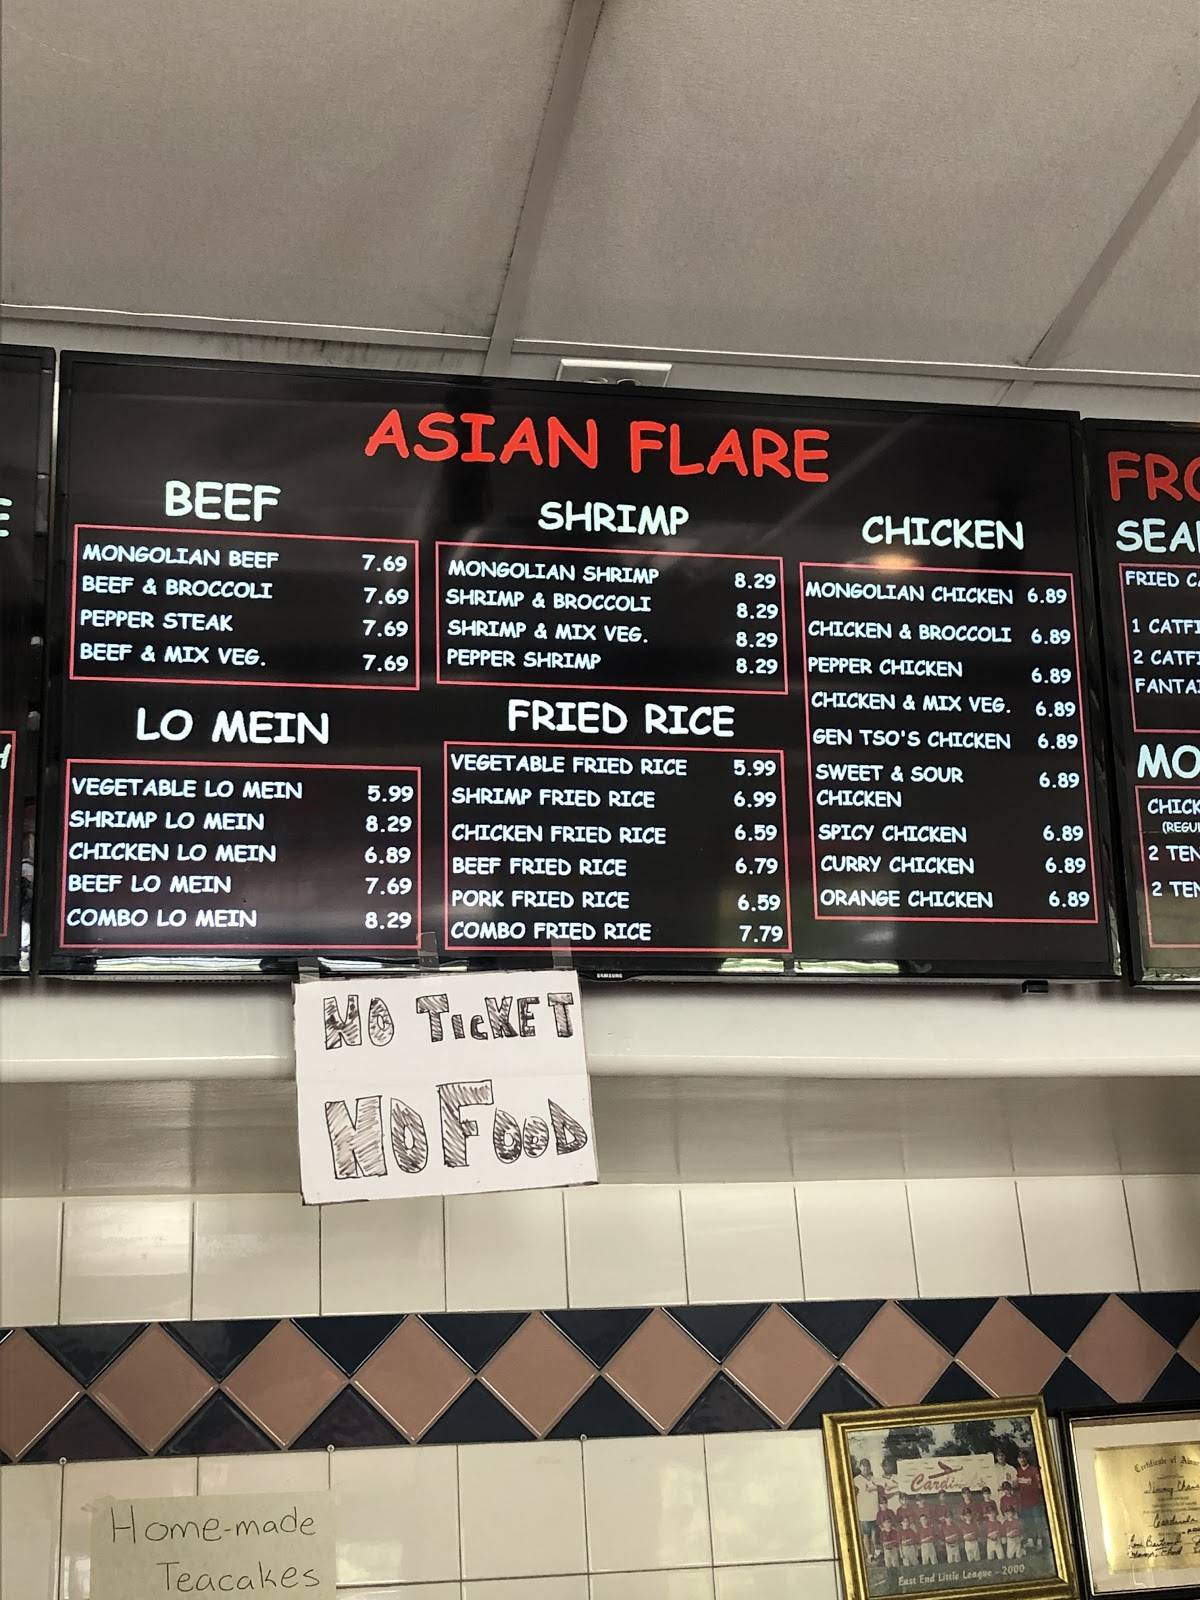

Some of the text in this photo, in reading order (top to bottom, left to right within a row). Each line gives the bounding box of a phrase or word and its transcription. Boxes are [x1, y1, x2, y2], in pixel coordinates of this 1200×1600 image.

[364, 407, 829, 482] ASIAN FLARE
[166, 481, 281, 522] BEEF
[538, 501, 689, 536] SHRIMP
[862, 516, 1023, 550] CHICKEN
[1116, 518, 1200, 553] SEA
[83, 544, 407, 572] MONGOLIAN BEEF 7.69
[449, 560, 776, 589] MONGOLIAN SHRIMP 8.29
[1125, 571, 1200, 588] FRIED C
[83, 575, 409, 604] BEEF & BROCCOLI 7.69
[806, 582, 1067, 604] MONGOLIAN CHICKEN 6.89
[446, 589, 778, 619] SHRIMP & BROCCOLI 8.29
[81, 609, 408, 637] PEPPER STEAK 7.69
[448, 620, 778, 648] SHRIMP & MIX VEG. 8.29
[808, 621, 1070, 644] CHICKEN & BROCCOLI 6.89
[1132, 619, 1140, 632] 1
[80, 643, 408, 671] BEEF & MIX VEG. 7.69
[447, 649, 777, 674] PEPPER SHRIMP 8.29
[1133, 650, 1143, 664] 2
[808, 657, 1071, 683] PEPPER CHICKEN 6.89
[812, 692, 1075, 717] CHICKEN & MIX VEG. 6.89
[137, 708, 328, 744] LO MEIN
[509, 699, 734, 737] FRIED RICE
[813, 729, 1078, 749] GEN TSO'S CHICKEN 6.89
[451, 754, 776, 776] VEGETABLE FRIED RICE 5.99
[816, 764, 1079, 788] SWEET & SOUR 6.89
[71, 775, 413, 802] VEGETABLE LO MEIN 5.99
[452, 787, 776, 808] SHRIMP FRIED RICE 6.99
[817, 790, 901, 807] CHICKEN
[68, 811, 412, 832] SHRIMP LO MEIN 8.29
[818, 824, 1083, 842] SPICY CHICKEN 6.89
[452, 824, 777, 844] CHICKEN FRIED RICE 6.59
[68, 842, 411, 864] CHICKEN LO MEIN 6.89
[821, 855, 1085, 874] CURRY CHICKEN 6.89
[1148, 845, 1159, 861] 2
[453, 857, 778, 876] BEEF FRIED RICE 6.79
[67, 875, 412, 895] BEEF LO MEIN 7.69
[1151, 881, 1162, 897] 2
[451, 890, 780, 911] PORK FRIED RICE 6.59
[820, 889, 1090, 908] ORANGE CHICKEN 6.89
[67, 908, 412, 929] COMBO LO MEIN 8.29
[451, 921, 783, 942] COMBO FRIED RICE 7.79
[324, 995, 395, 1050] NO
[325, 1095, 429, 1180] NO
[111, 1505, 316, 1544] Home-made
[156, 1561, 321, 1592] Teacakes
[898, 1575, 917, 1587] East
[919, 1573, 935, 1584] End
[938, 1570, 960, 1582] Little
[962, 1569, 993, 1581] League
[1001, 1564, 1026, 1576] 2000
